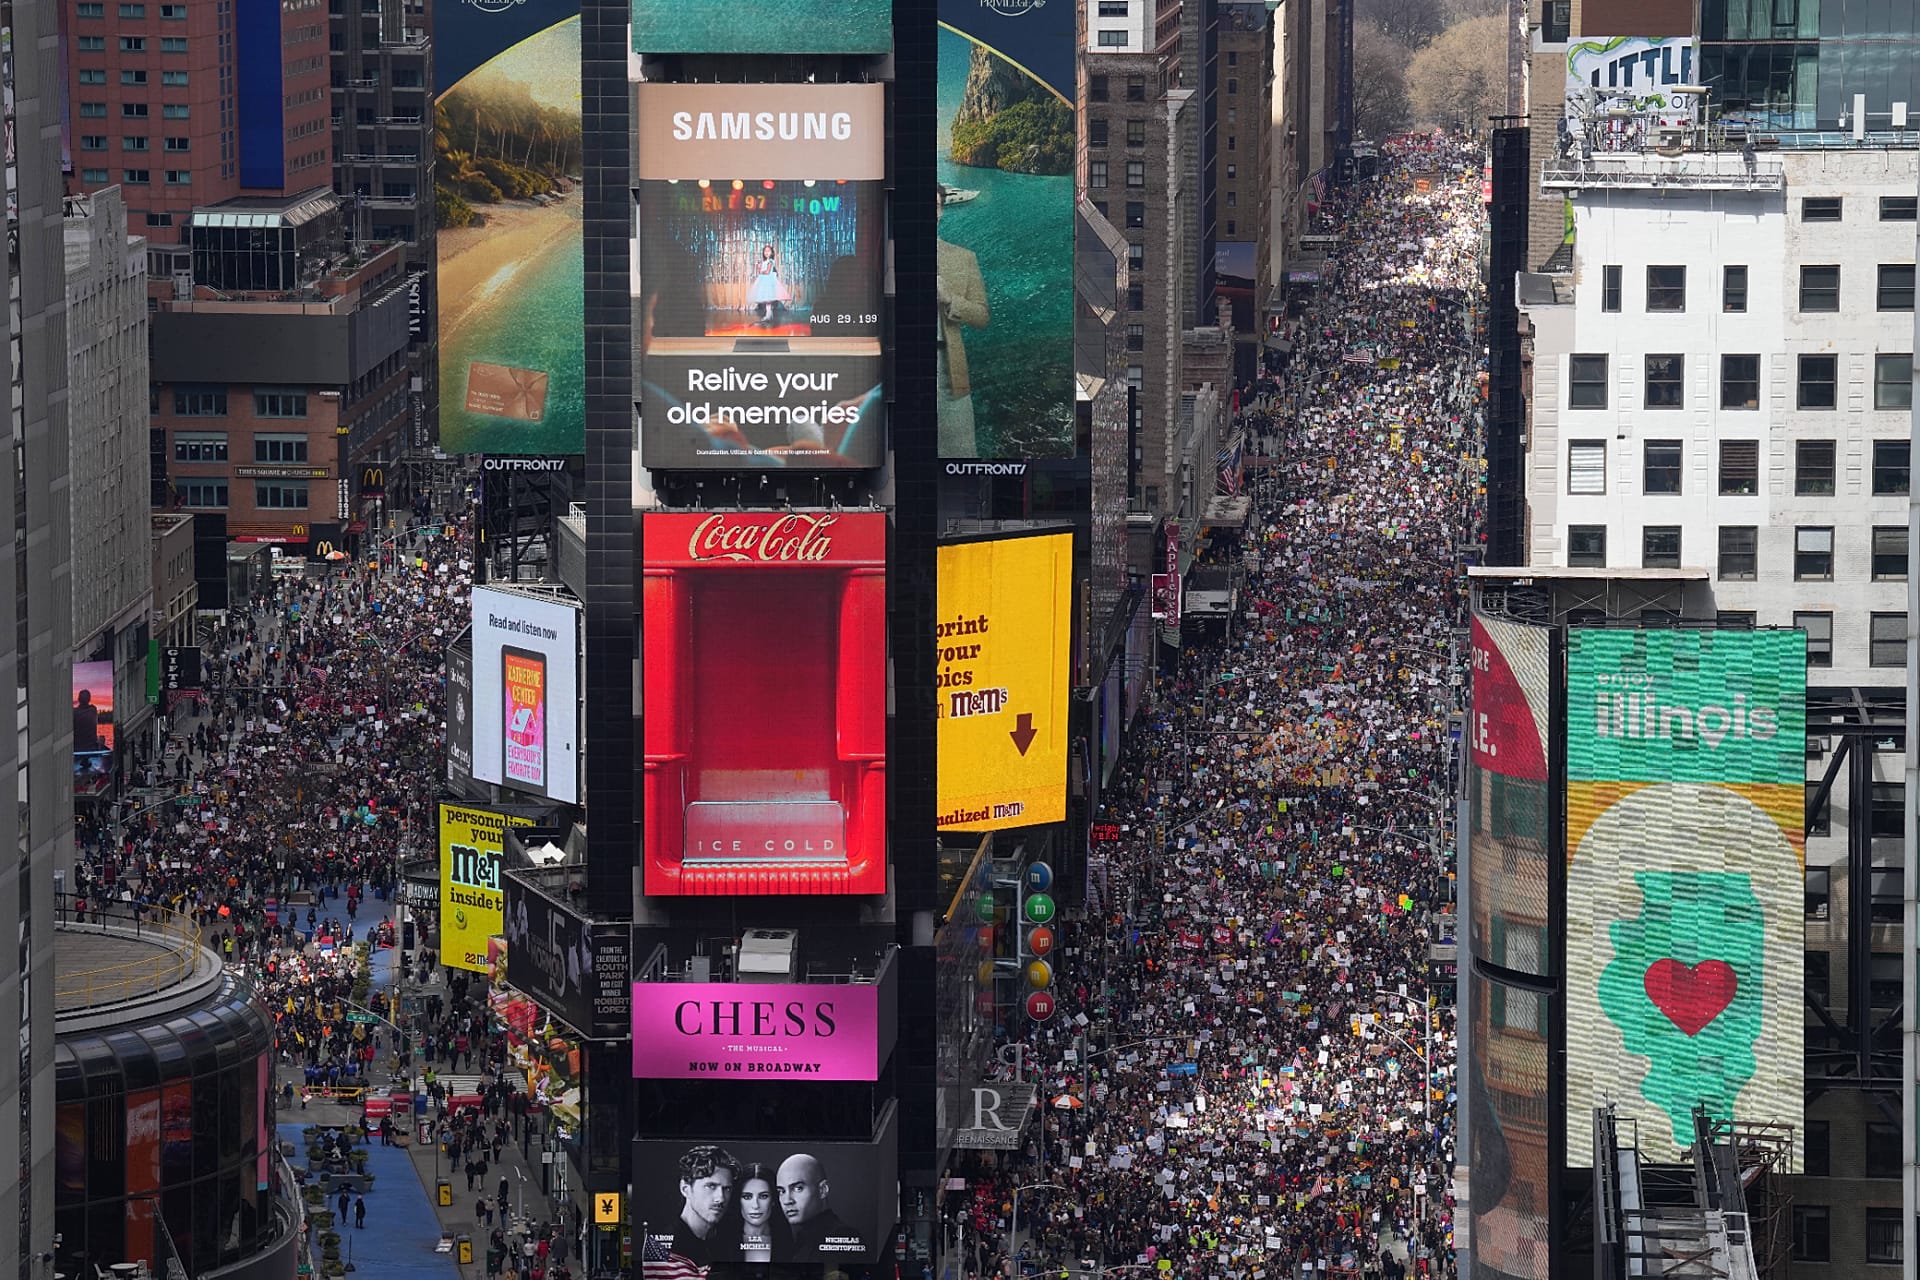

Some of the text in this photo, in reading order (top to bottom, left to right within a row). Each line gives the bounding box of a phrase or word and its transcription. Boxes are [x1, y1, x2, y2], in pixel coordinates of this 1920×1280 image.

[673, 111, 851, 140] SAMSUNG
[810, 315, 830, 323] AUG
[688, 367, 838, 398] Relive your
[667, 400, 860, 424] old memories
[489, 613, 557, 640] Read and listen now
[1472, 646, 1489, 672] ORE
[167, 650, 179, 689] GIFTS
[508, 664, 541, 688] KATHERINE
[1598, 672, 1655, 690] enjoy
[512, 685, 536, 706] CENTER
[1597, 692, 1777, 751] illinois
[471, 828, 503, 843] your
[698, 840, 834, 851] ICE COLD
[450, 887, 493, 910] inside
[465, 952, 476, 965] 22
[595, 963, 628, 971] SOUTH
[599, 972, 625, 980] PARK
[594, 997, 630, 1006] ROBERT
[597, 1006, 627, 1014] LOPEZ
[675, 1000, 836, 1037] CHESS
[689, 1062, 821, 1073] NOW ON BROADWAY
[971, 1088, 1016, 1131] R
[958, 1135, 1018, 1145] RENAISSANCE
[819, 1244, 866, 1252] CHRISTOPHER
